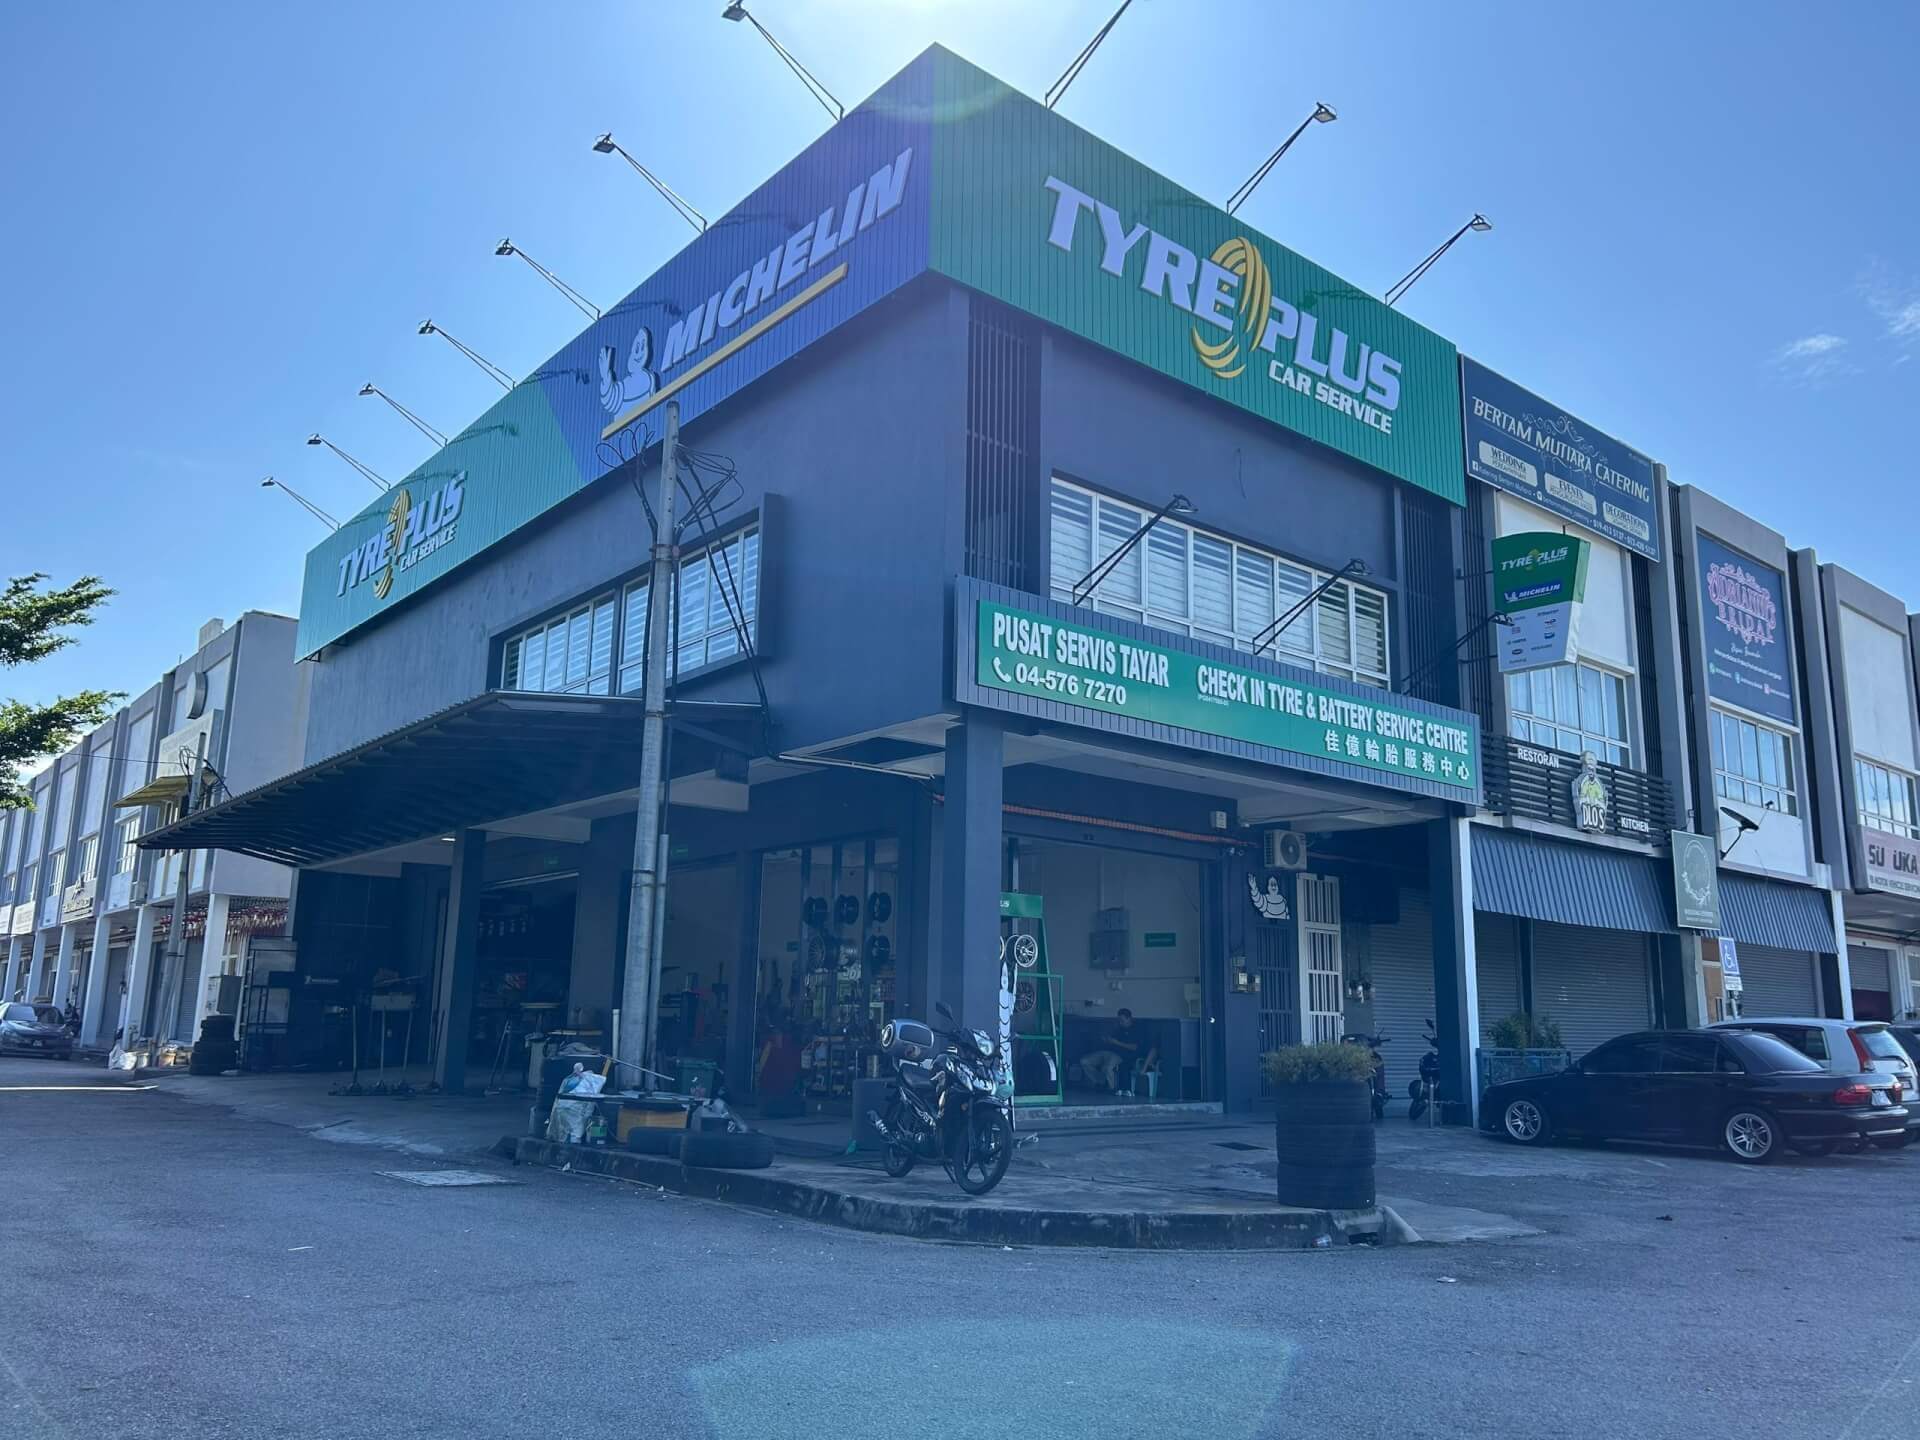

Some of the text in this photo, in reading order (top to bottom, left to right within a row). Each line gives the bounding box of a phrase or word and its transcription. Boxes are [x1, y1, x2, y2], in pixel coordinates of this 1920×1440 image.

[660, 147, 913, 373] MICHELIN
[1268, 359, 1393, 434] CAR SERVICE
[1472, 396, 1531, 443] BERTAM
[1535, 430, 1592, 473] MUTIARA
[1596, 463, 1649, 503] CATERING
[401, 523, 457, 573] CAR SERVICE
[1518, 583, 1561, 598] MICHELIN
[993, 612, 1170, 688] PUSAT SERVIS TAYAR
[1015, 662, 1127, 705] 04-576 7270
[1198, 664, 1469, 754] CHECK IN TYRE & BATTERY SERVICE CENTRE
[1324, 729, 1470, 781] 佳億輪胎服務中心
[1517, 748, 1560, 768] RESTORAN
[1620, 816, 1649, 833] KITCHEN
